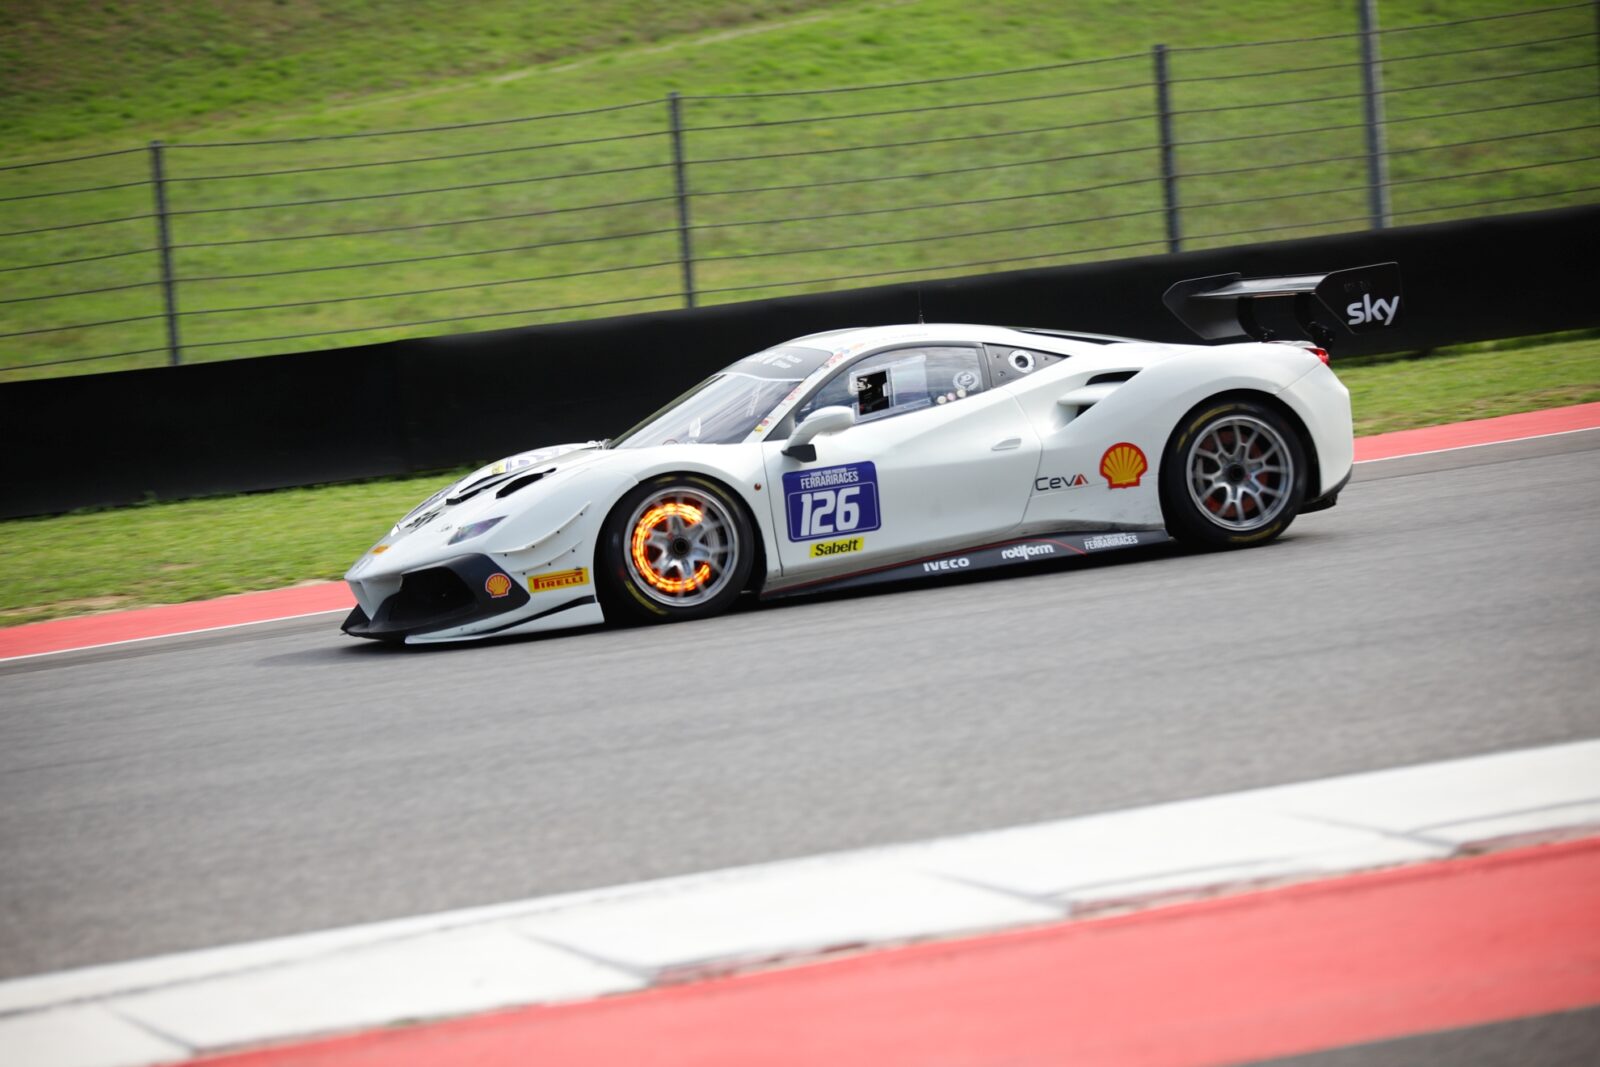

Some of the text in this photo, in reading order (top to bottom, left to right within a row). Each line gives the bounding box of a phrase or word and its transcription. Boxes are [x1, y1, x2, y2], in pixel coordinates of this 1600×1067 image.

[1347, 293, 1399, 325] sky
[800, 471, 859, 489] FERRARIRACES
[800, 486, 861, 536] 126
[815, 539, 858, 556] Sabelt
[1084, 535, 1138, 550] FERRARIRACES
[1002, 544, 1054, 560] rotiform
[923, 558, 970, 572] IVECO
[533, 571, 583, 590] PIRELLI
